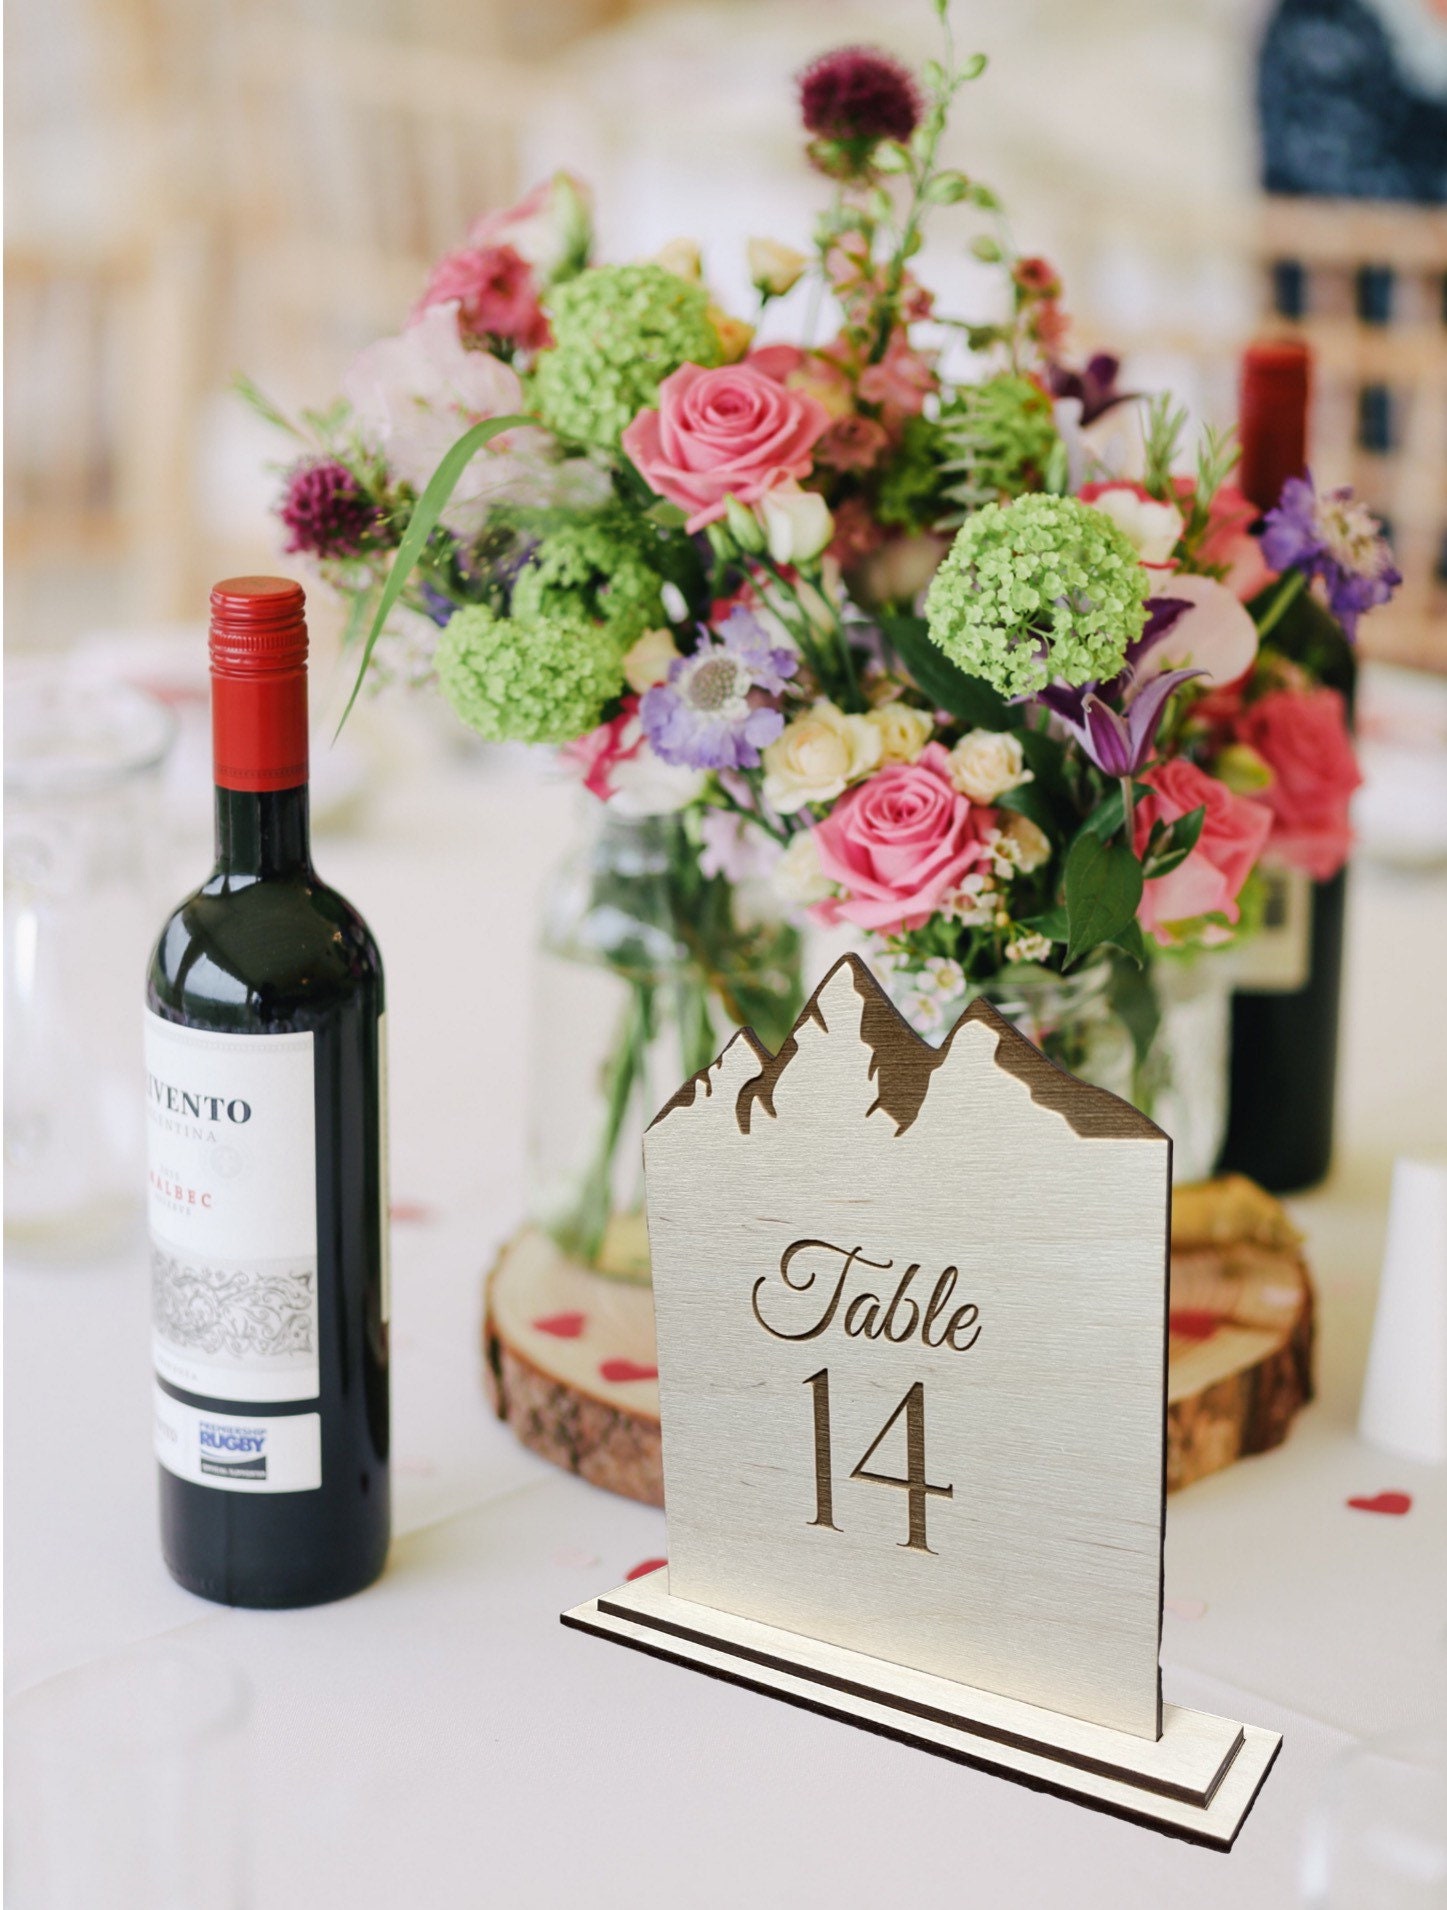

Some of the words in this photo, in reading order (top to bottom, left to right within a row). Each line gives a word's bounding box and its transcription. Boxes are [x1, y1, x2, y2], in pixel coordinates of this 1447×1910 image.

[751, 1238, 983, 1352] Table
[200, 1431, 265, 1452] RUGBY
[802, 1367, 954, 1556] 14
